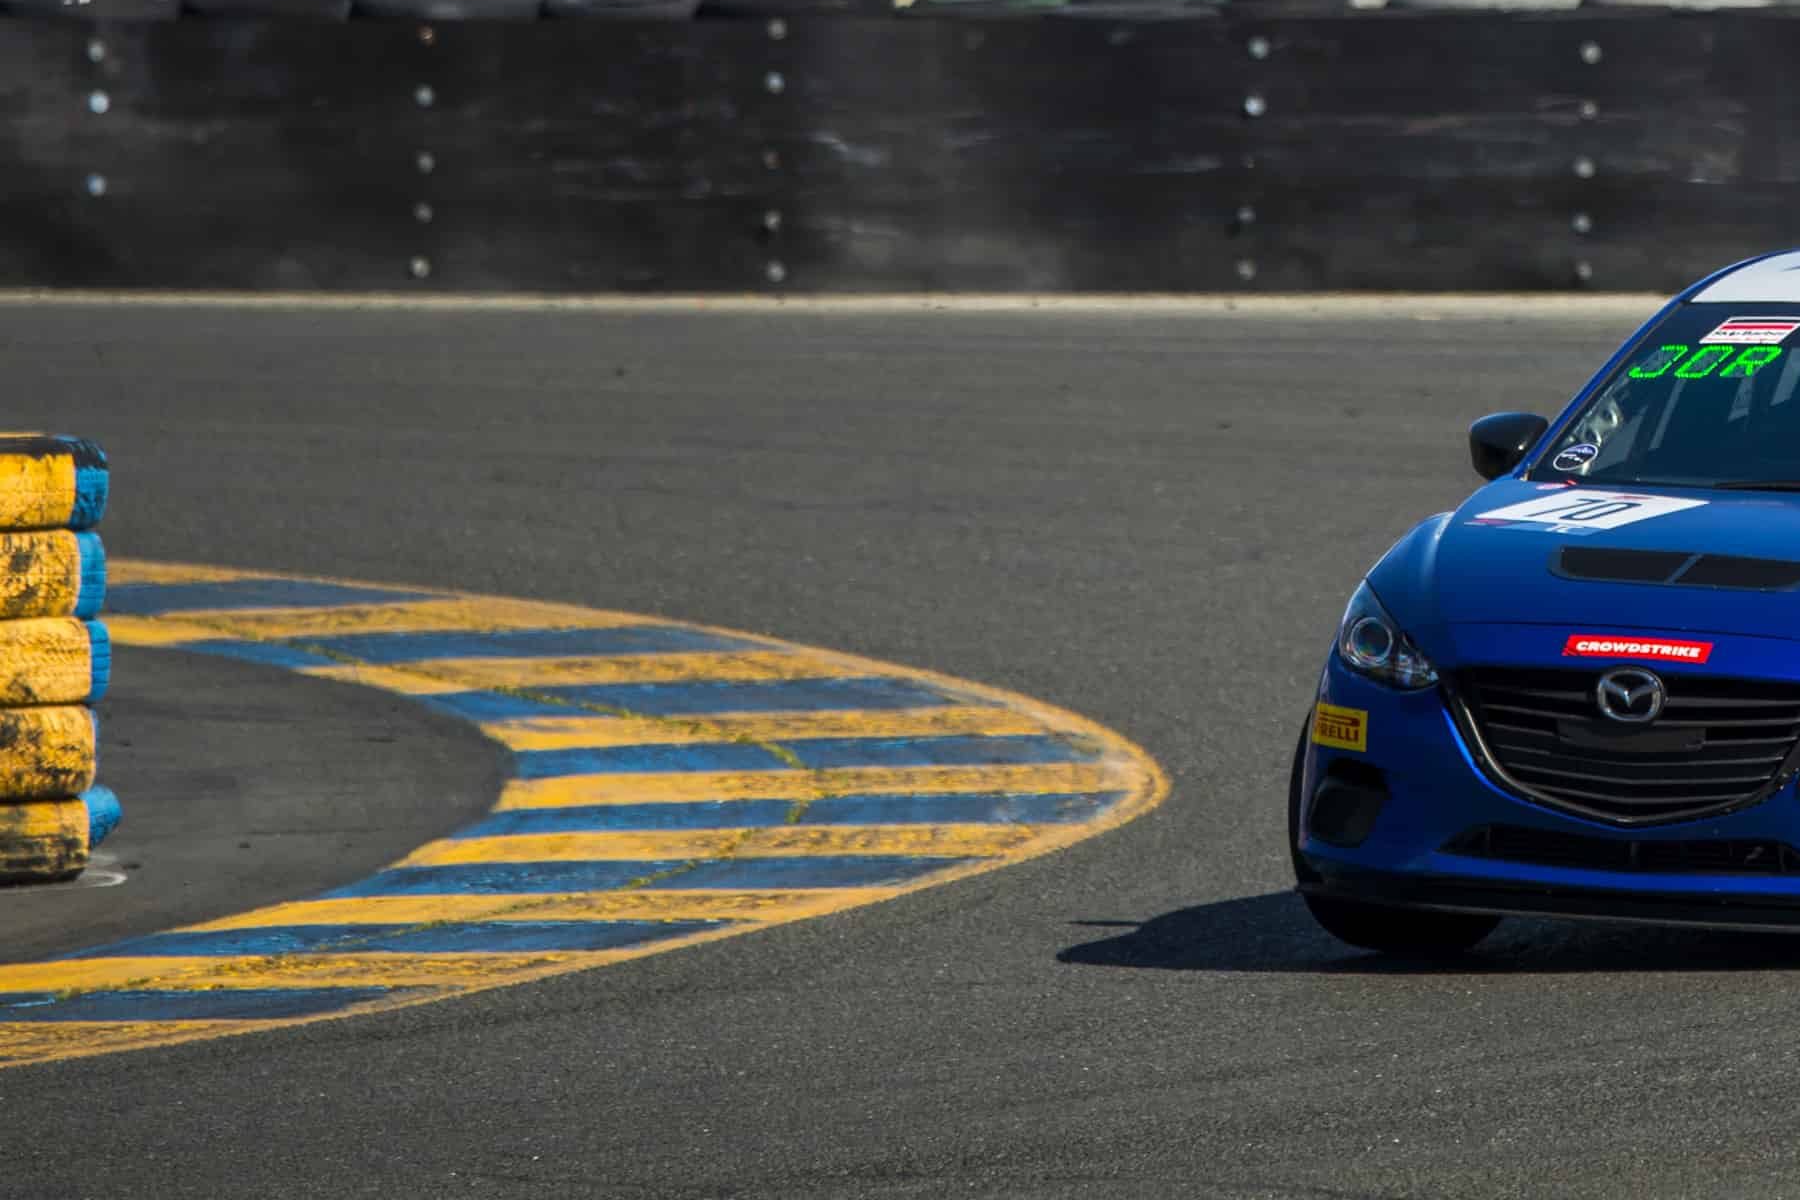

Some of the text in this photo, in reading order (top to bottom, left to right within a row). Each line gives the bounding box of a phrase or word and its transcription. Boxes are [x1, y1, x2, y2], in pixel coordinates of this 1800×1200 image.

[1628, 345, 1782, 378] JOR
[1523, 498, 1642, 521] 70
[1576, 641, 1701, 658] CROWDSTRIKE
